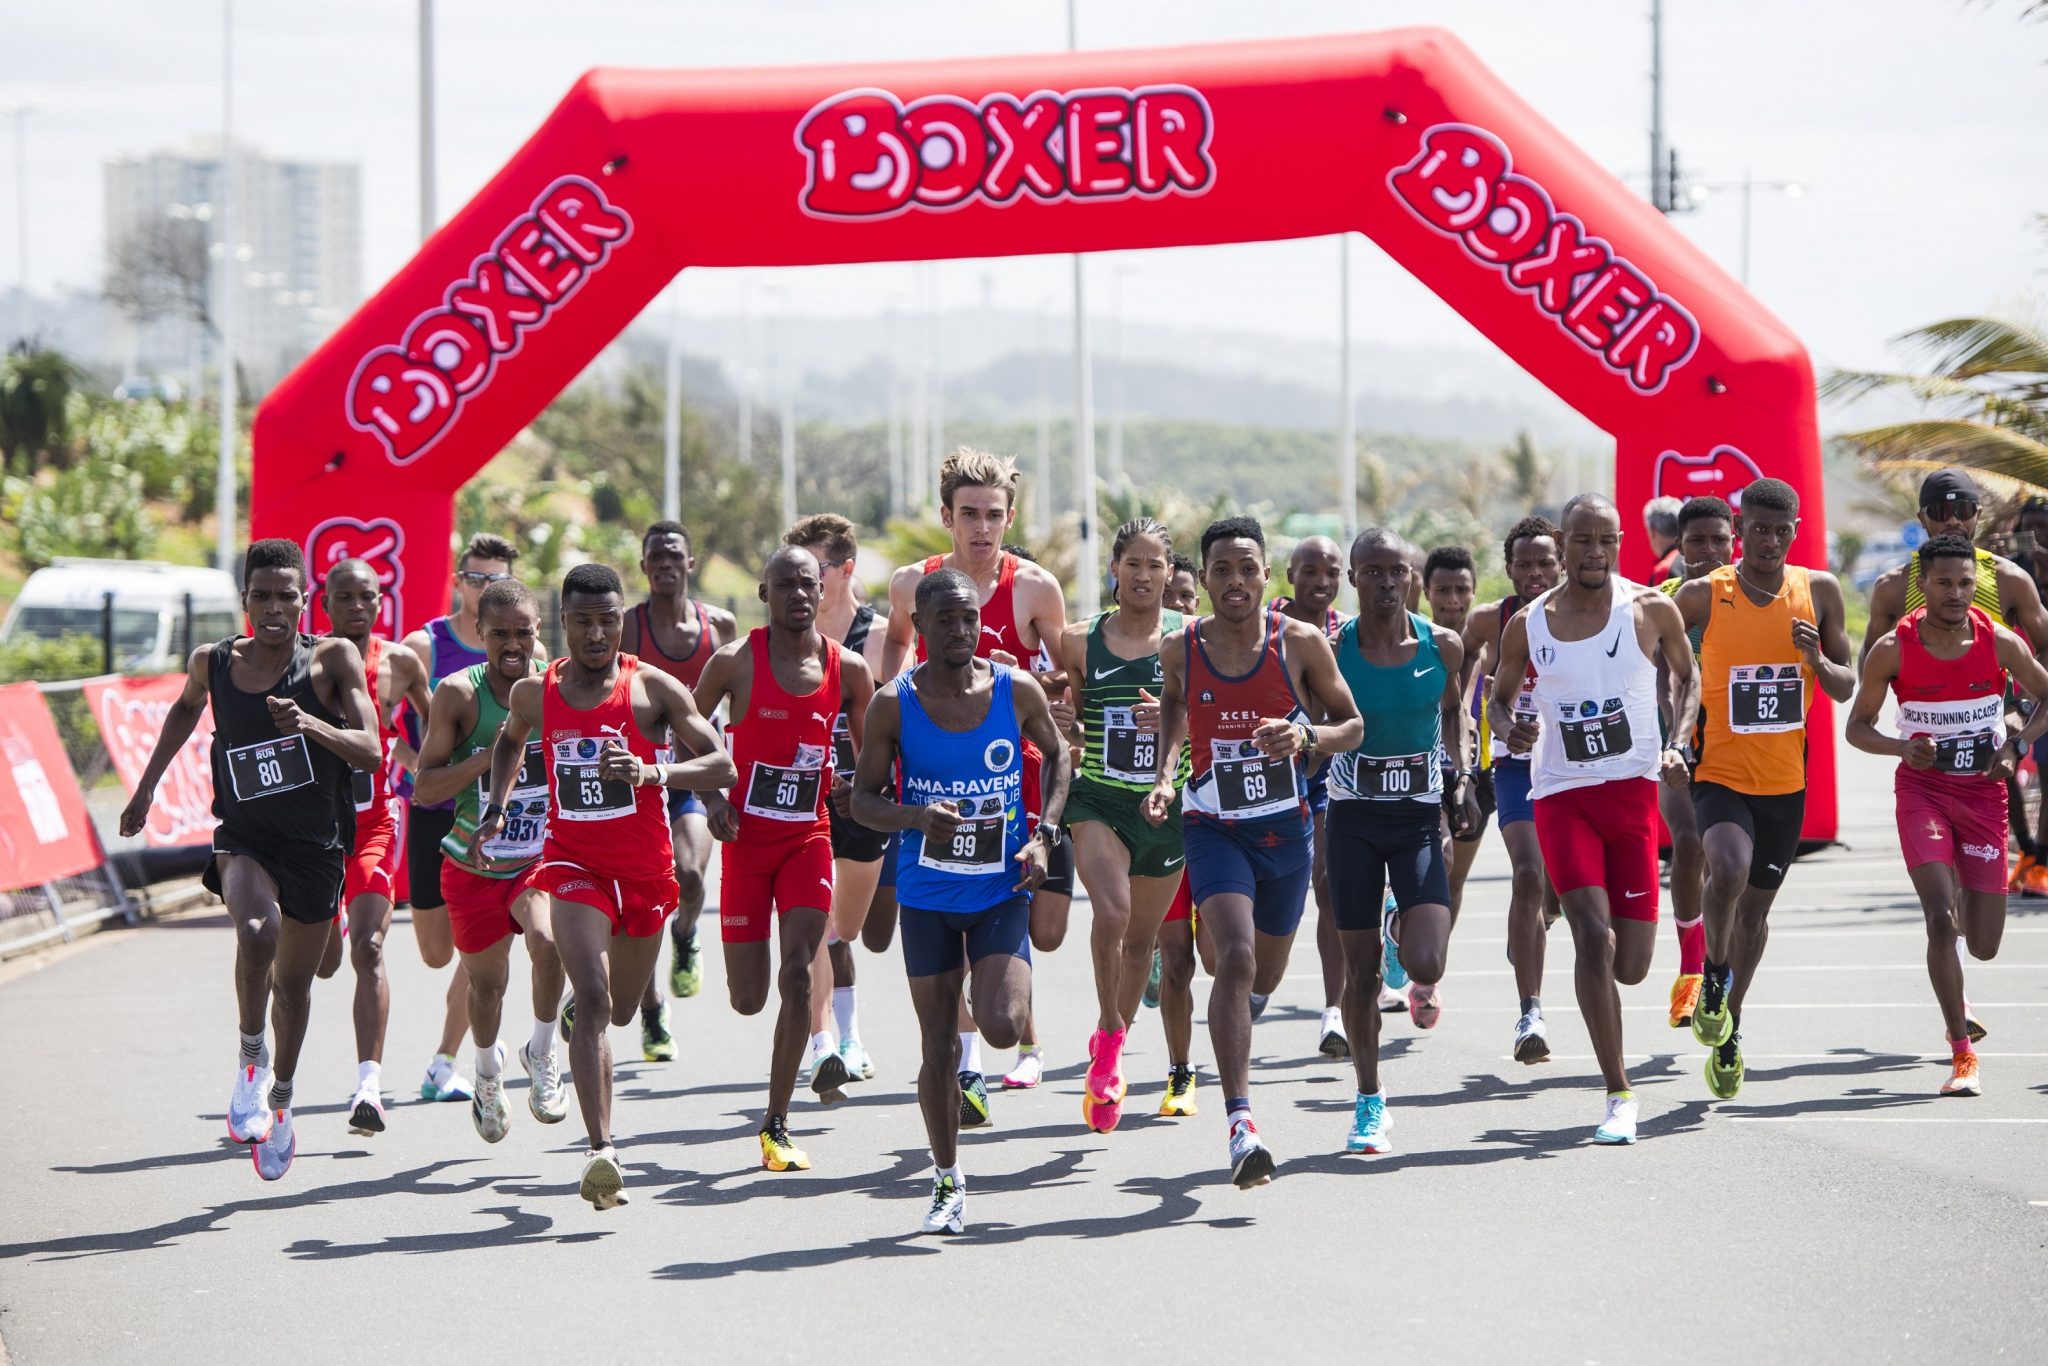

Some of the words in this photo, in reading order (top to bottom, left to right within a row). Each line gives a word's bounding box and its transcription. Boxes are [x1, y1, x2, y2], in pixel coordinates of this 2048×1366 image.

[796, 88, 1215, 220] BOXER
[1387, 123, 1699, 395] BOXER
[346, 174, 633, 464] BOXER
[1780, 668, 1796, 676] ASA
[1759, 685, 1777, 694] RUN
[1605, 699, 1622, 709] ASA
[1758, 696, 1779, 719] 52
[1220, 711, 1259, 720] XCEL
[1931, 710, 1970, 726] RUNNING
[1583, 722, 1602, 732] RUN
[1136, 734, 1154, 742] RUN
[1585, 732, 1608, 755] 61
[1957, 740, 1974, 749] RUN
[256, 747, 276, 760] RUN
[1134, 745, 1154, 768] 58
[1954, 750, 1974, 769] 85
[1242, 763, 1263, 774] RUN
[1385, 760, 1404, 768] RUN
[258, 760, 283, 787] 80
[580, 769, 600, 778] RUN
[781, 773, 800, 782] RUN
[1380, 769, 1410, 792] 100
[907, 770, 1020, 795] AMA-RAVENS
[1244, 775, 1267, 801] 69
[580, 781, 604, 805] 53
[776, 783, 798, 806] 50
[983, 799, 1000, 809] ASA
[956, 823, 976, 832] RUN
[952, 835, 977, 857] 99
